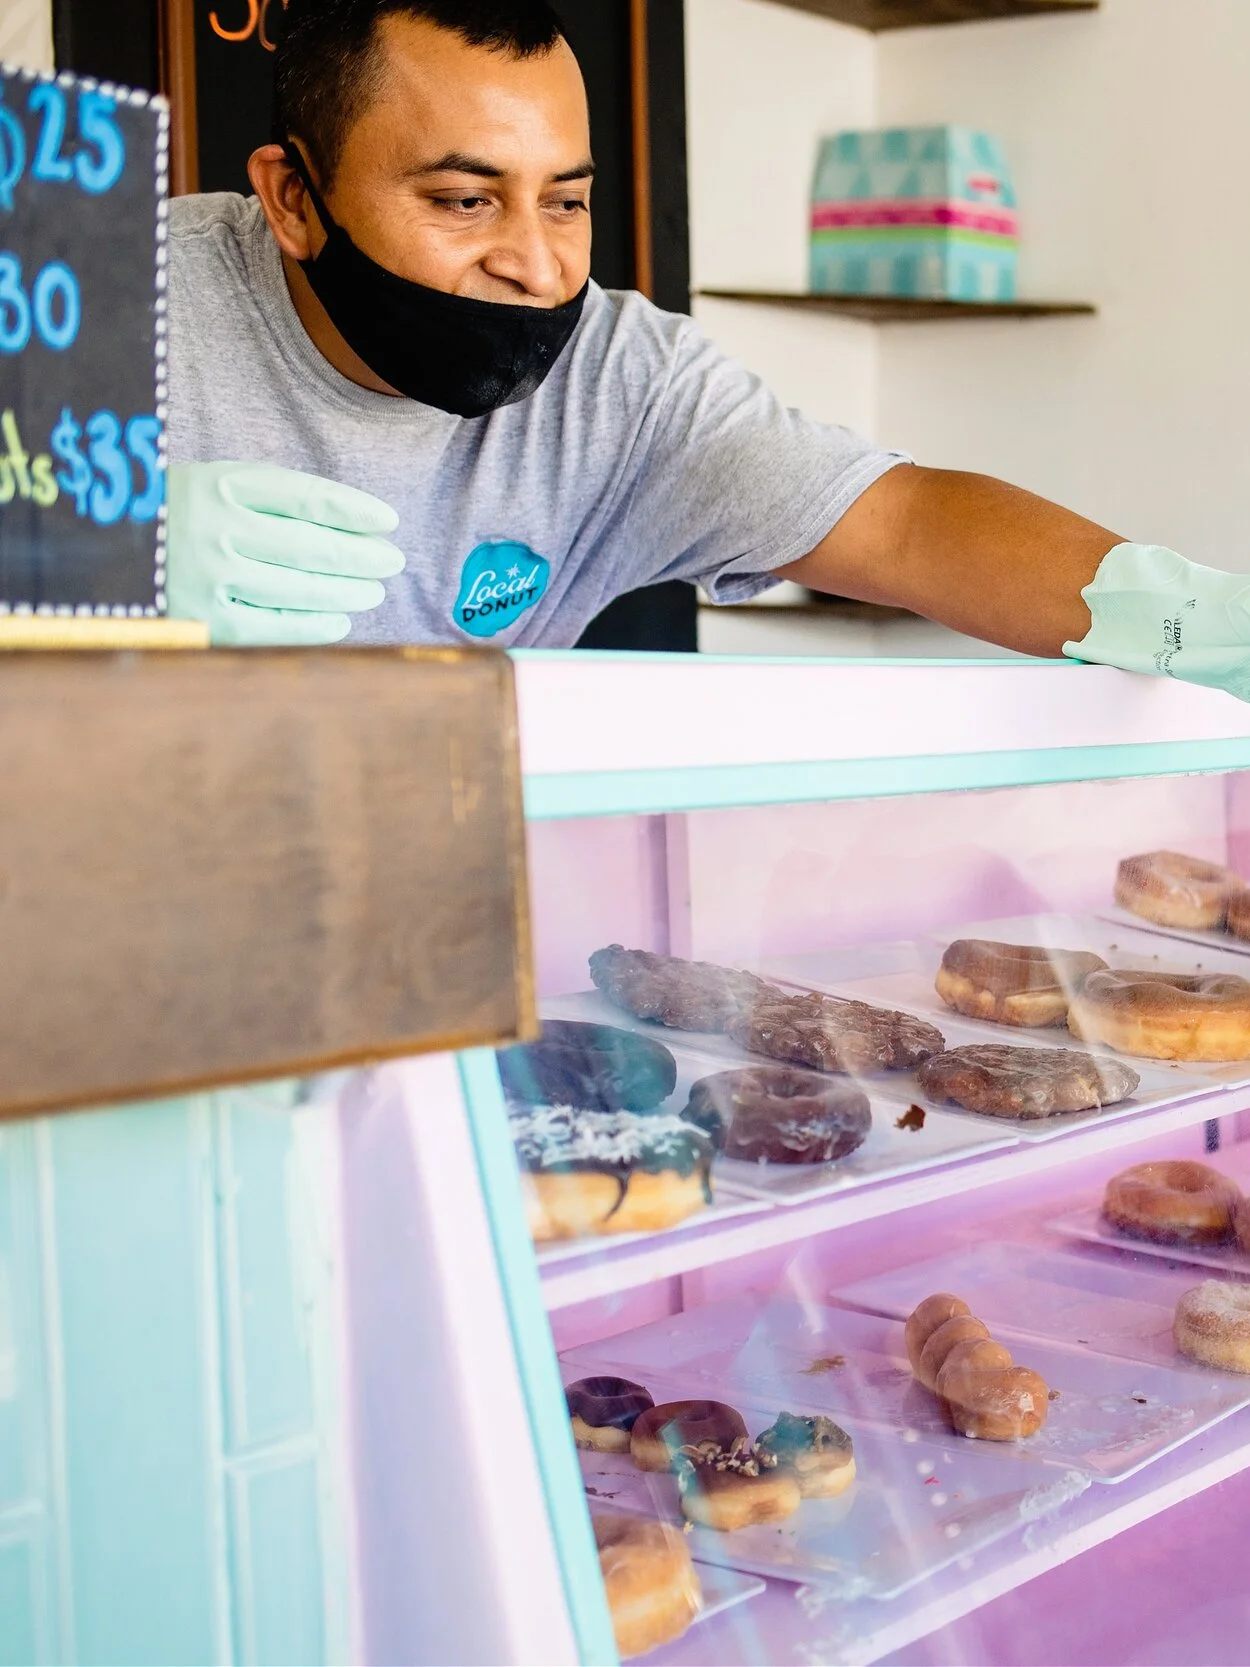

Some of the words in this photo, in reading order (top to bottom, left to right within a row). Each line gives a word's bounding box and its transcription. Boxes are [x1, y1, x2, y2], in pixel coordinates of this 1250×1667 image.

[51, 405, 165, 525] $35
[461, 564, 539, 609] Local
[463, 587, 538, 622] DONUT
